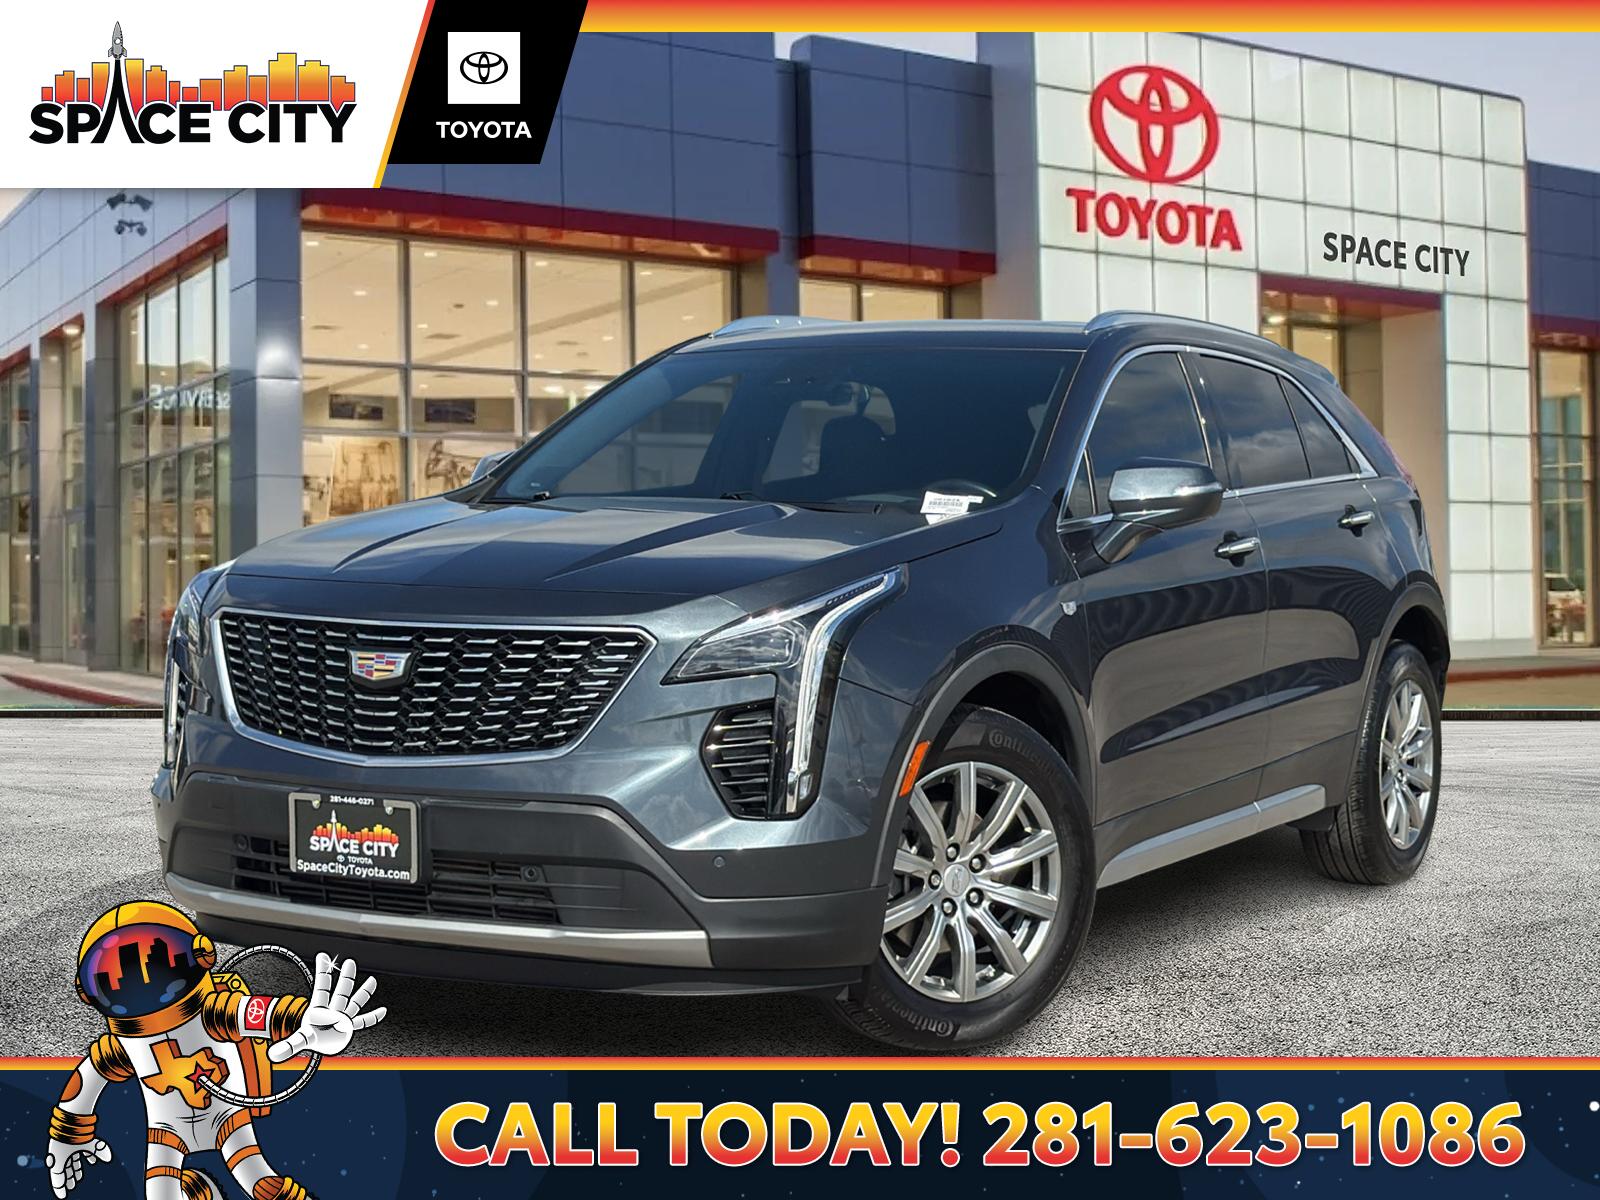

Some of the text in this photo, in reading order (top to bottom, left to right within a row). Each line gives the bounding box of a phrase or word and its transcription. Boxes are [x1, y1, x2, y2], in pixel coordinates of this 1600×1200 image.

[1066, 188, 1242, 251] TOYOTA
[1323, 232, 1470, 276] SPACE CITY
[309, 821, 400, 858] SPACE CITY
[297, 859, 410, 880] SpaceCityToyota.com
[347, 856, 373, 865] TOYOTA
